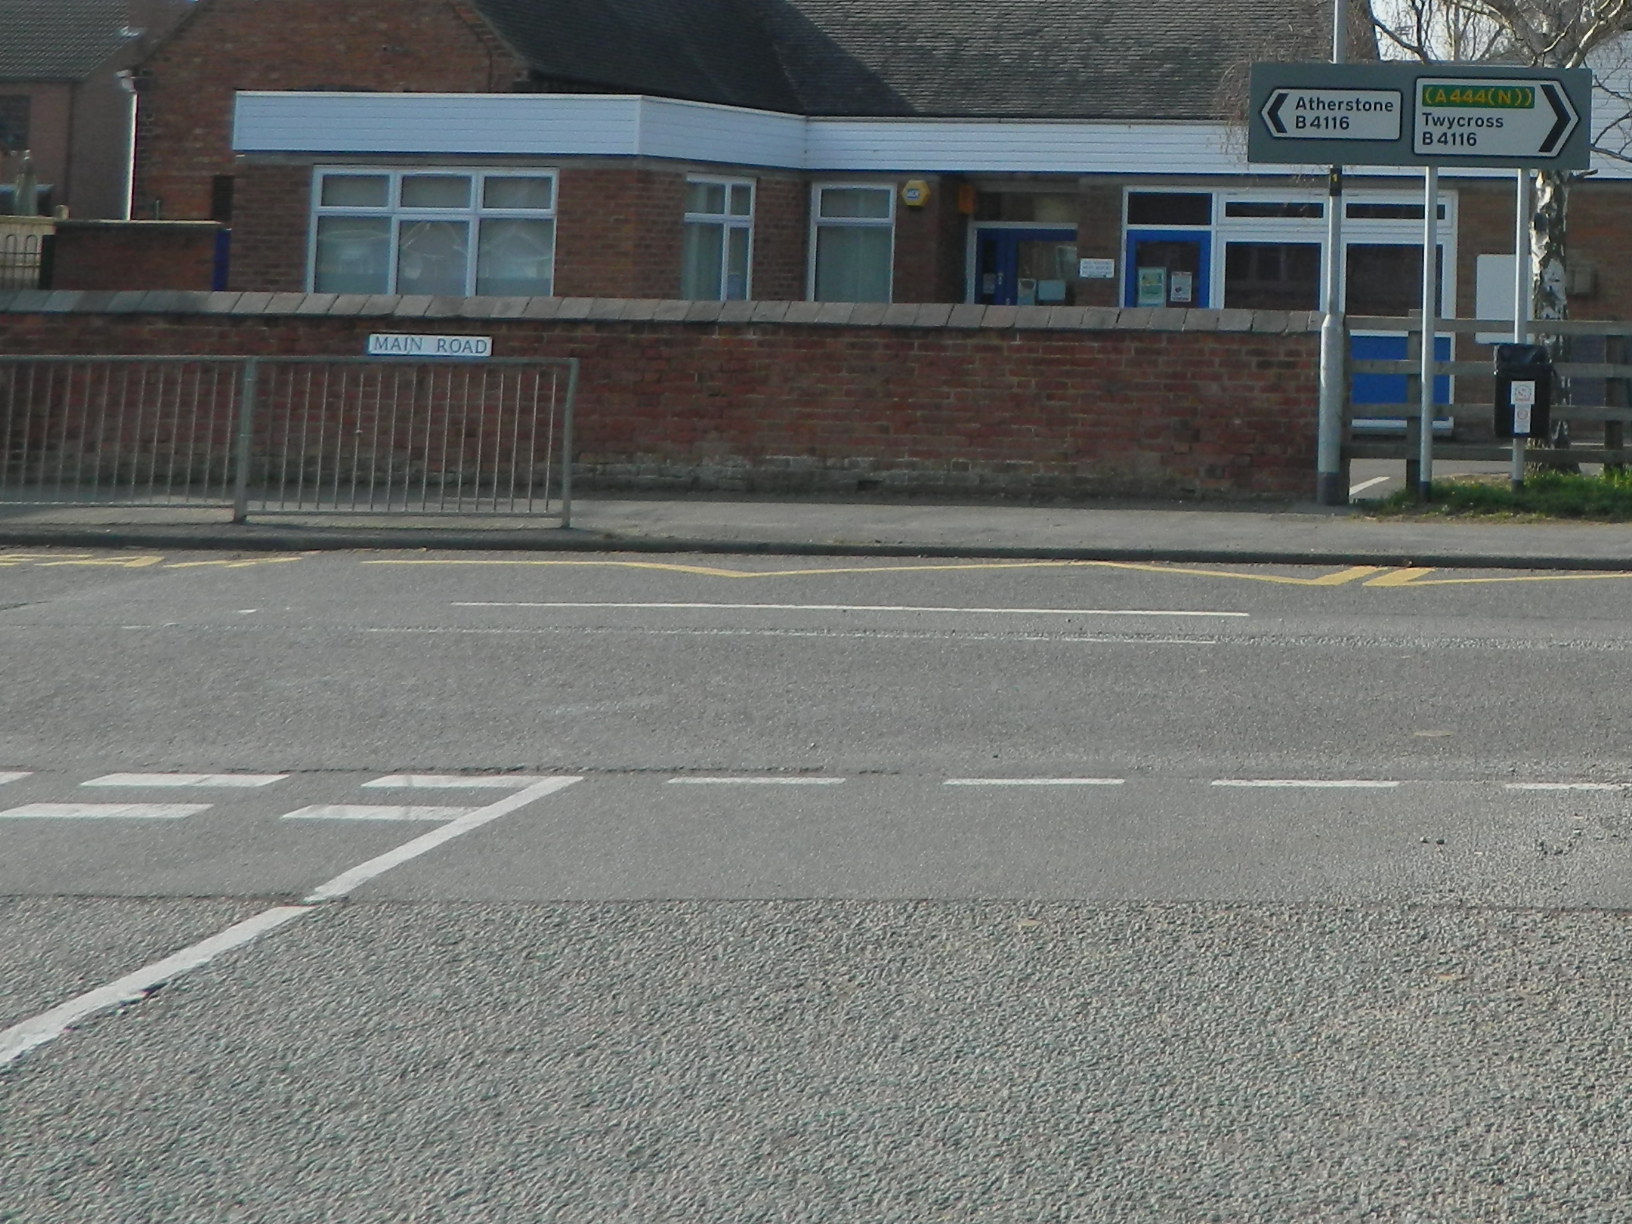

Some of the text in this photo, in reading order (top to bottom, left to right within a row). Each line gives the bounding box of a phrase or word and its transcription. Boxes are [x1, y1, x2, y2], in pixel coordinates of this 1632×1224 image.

[1295, 96, 1394, 113] Atherstone
[1422, 112, 1504, 129] Twycross
[374, 336, 488, 354] MAIN ROAD
